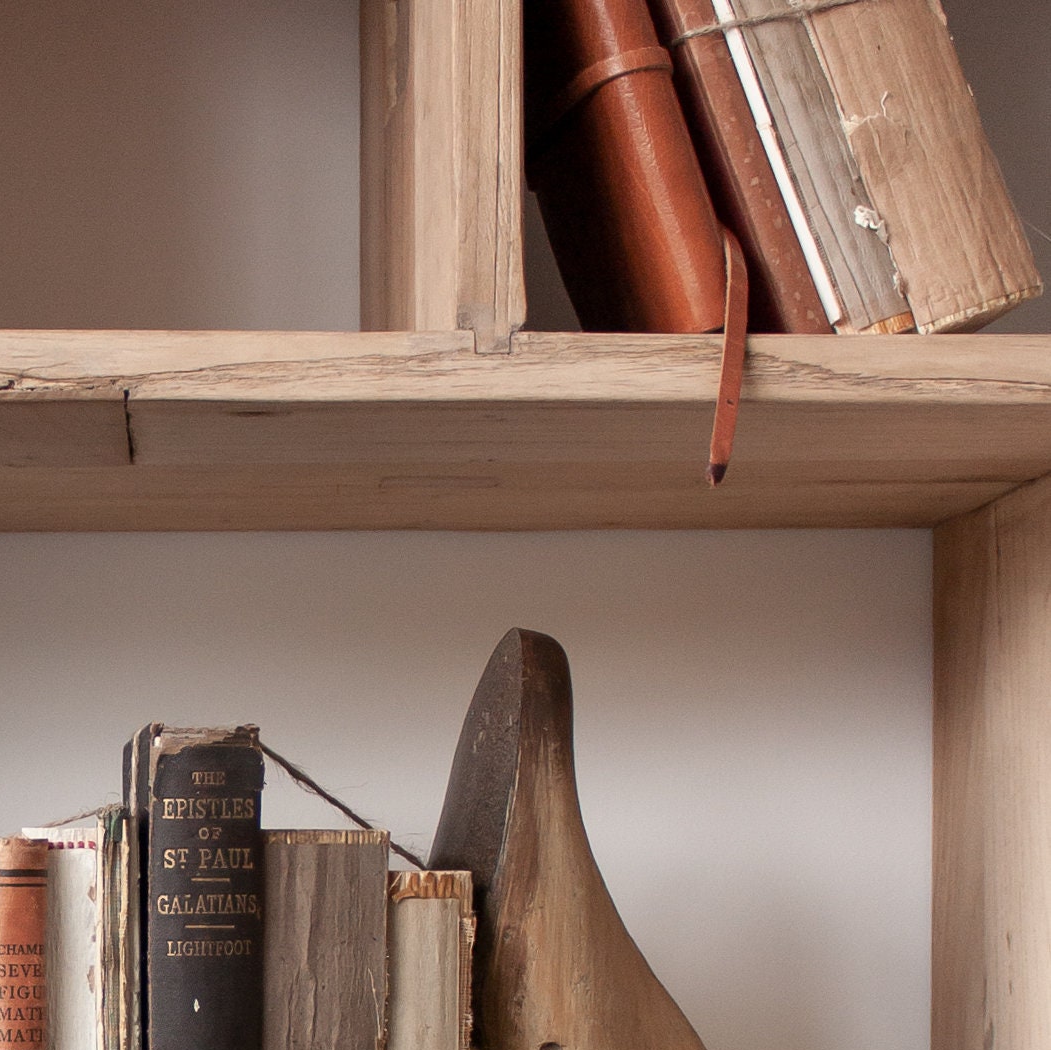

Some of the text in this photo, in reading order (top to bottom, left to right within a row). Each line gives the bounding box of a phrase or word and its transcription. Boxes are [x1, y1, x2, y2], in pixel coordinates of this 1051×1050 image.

[192, 771, 225, 785] THE
[162, 798, 255, 819] EPISTLES
[198, 827, 223, 840] OF
[199, 849, 254, 869] PAUL
[157, 894, 257, 915] GALATIANS
[166, 940, 252, 956] LIGHTFOOT
